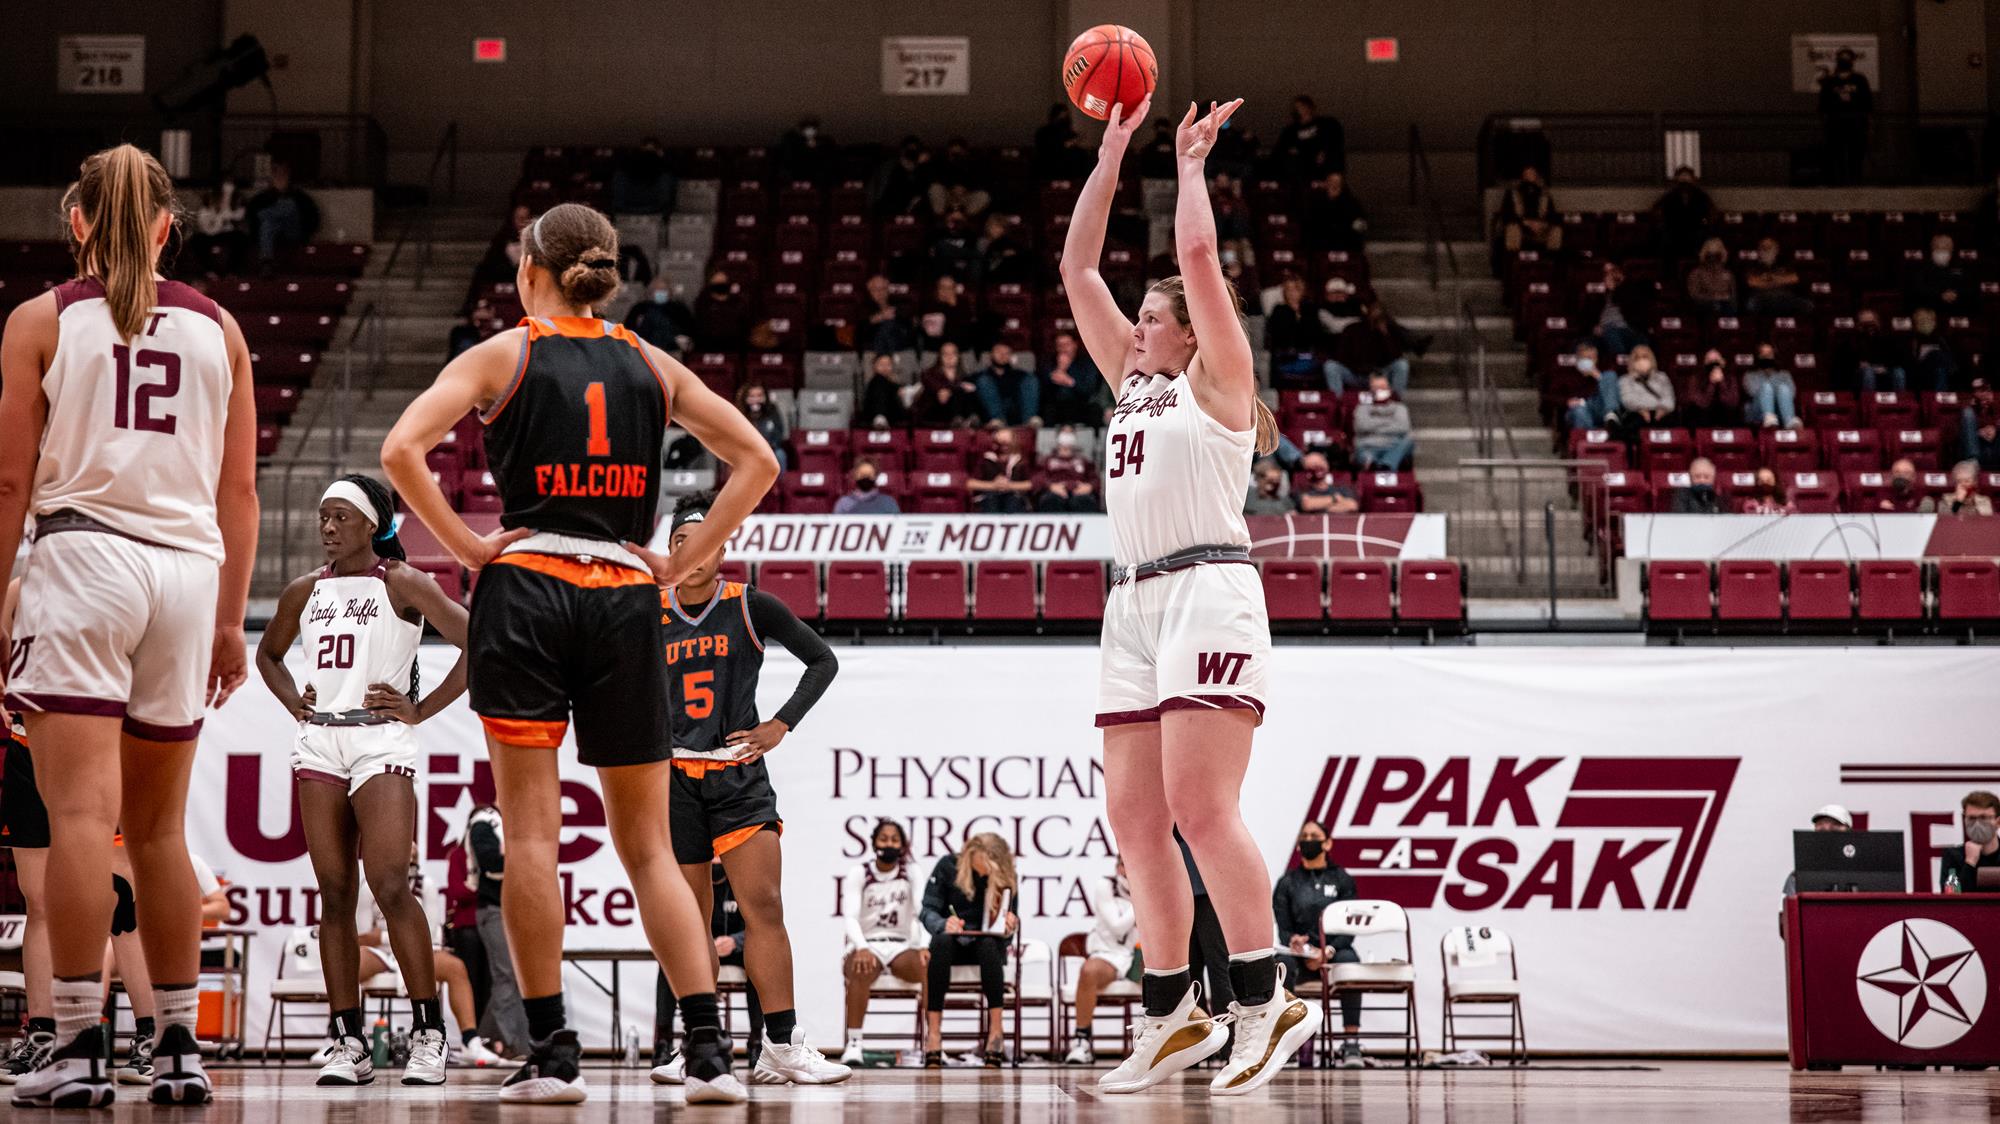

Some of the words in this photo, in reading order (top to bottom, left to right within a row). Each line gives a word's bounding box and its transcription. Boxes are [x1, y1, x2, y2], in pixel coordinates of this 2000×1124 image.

[905, 69, 947, 88] 217
[112, 343, 182, 435] 12
[584, 381, 611, 456] 1
[1109, 430, 1145, 478] 34
[725, 523, 892, 552] RADITION
[902, 530, 929, 546] IN
[938, 523, 1082, 552] MOTION
[308, 600, 338, 627] Lady
[342, 598, 379, 626] Buffs
[317, 633, 355, 671] 20
[665, 634, 729, 666] UTPB
[1197, 652, 1253, 686] WT
[683, 669, 715, 720] 5
[1349, 756, 1567, 827] PAK
[1444, 837, 1673, 911] SAK
